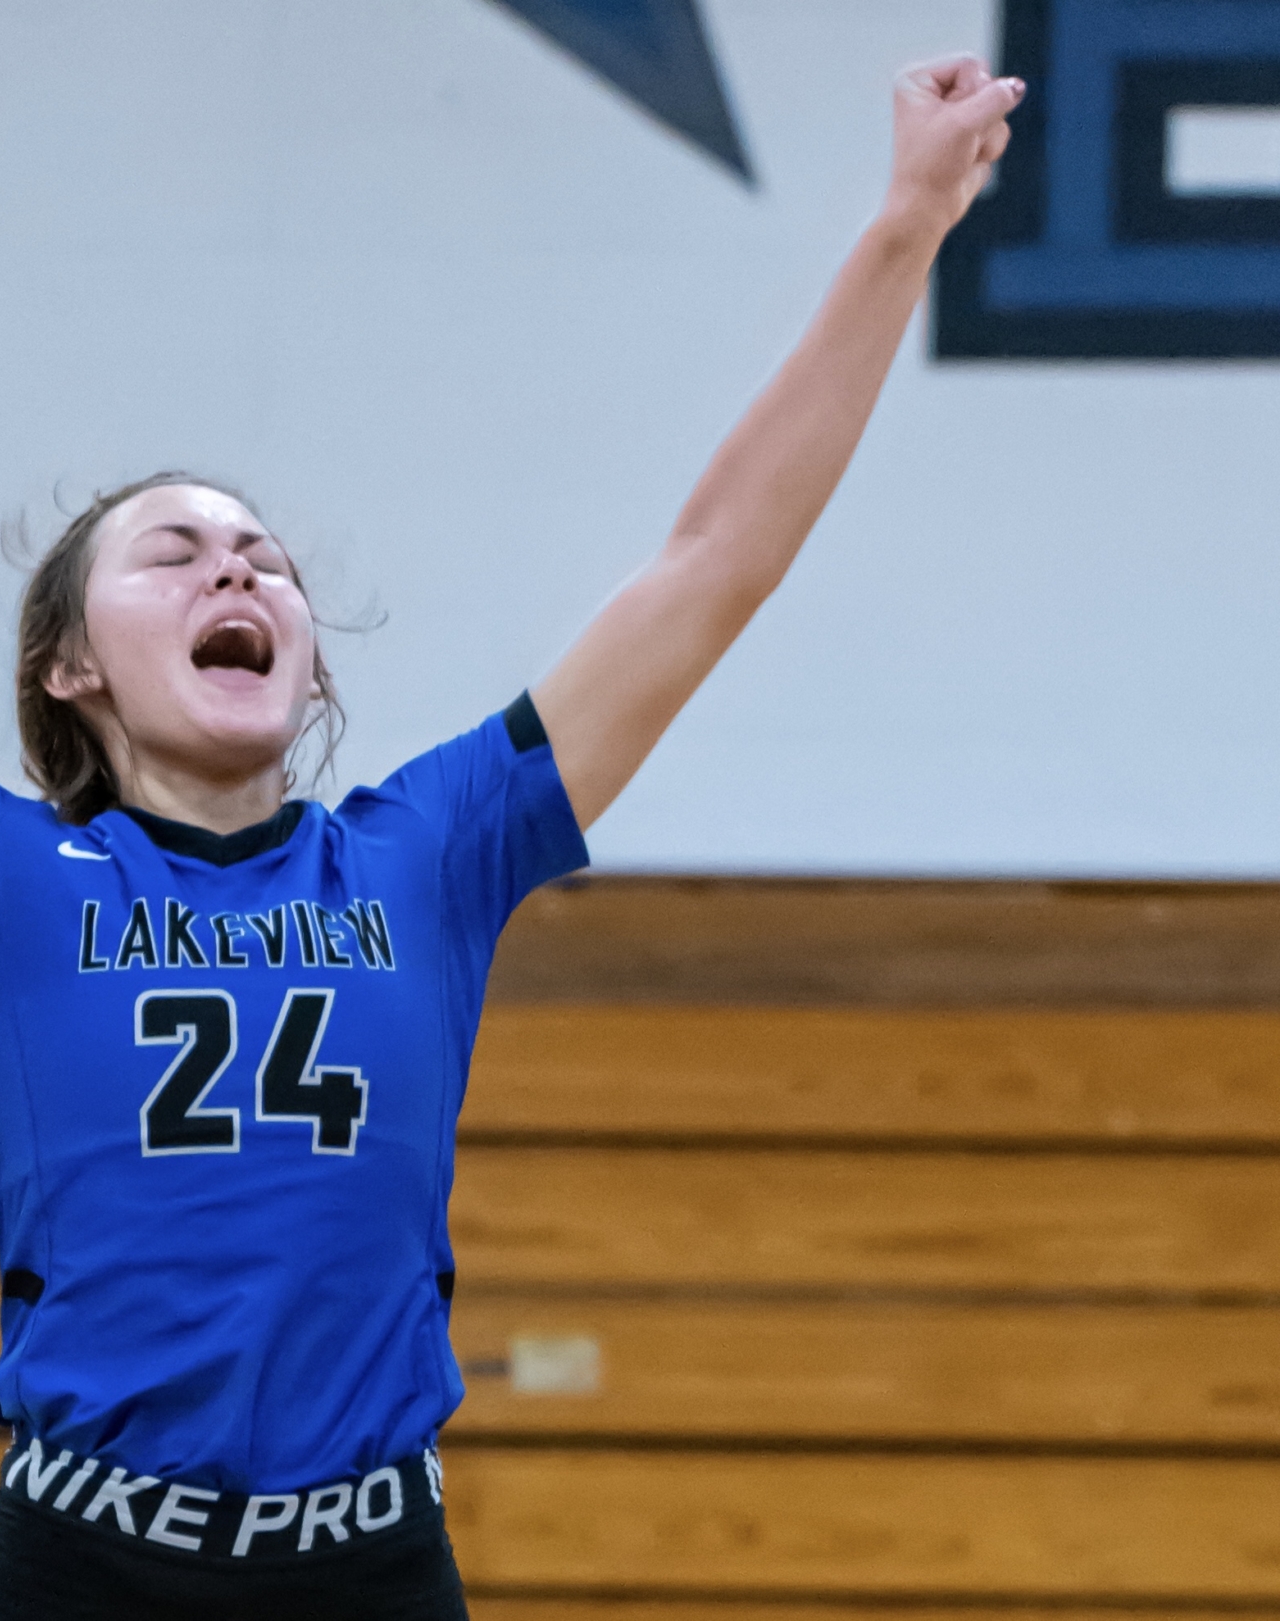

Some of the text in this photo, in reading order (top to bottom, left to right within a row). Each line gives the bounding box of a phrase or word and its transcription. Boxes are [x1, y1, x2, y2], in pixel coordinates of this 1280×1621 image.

[78, 897, 396, 973] LAKEVIEW
[134, 987, 369, 1158] 24
[5, 1437, 220, 1552] NIKE
[231, 1466, 403, 1557] PRO
